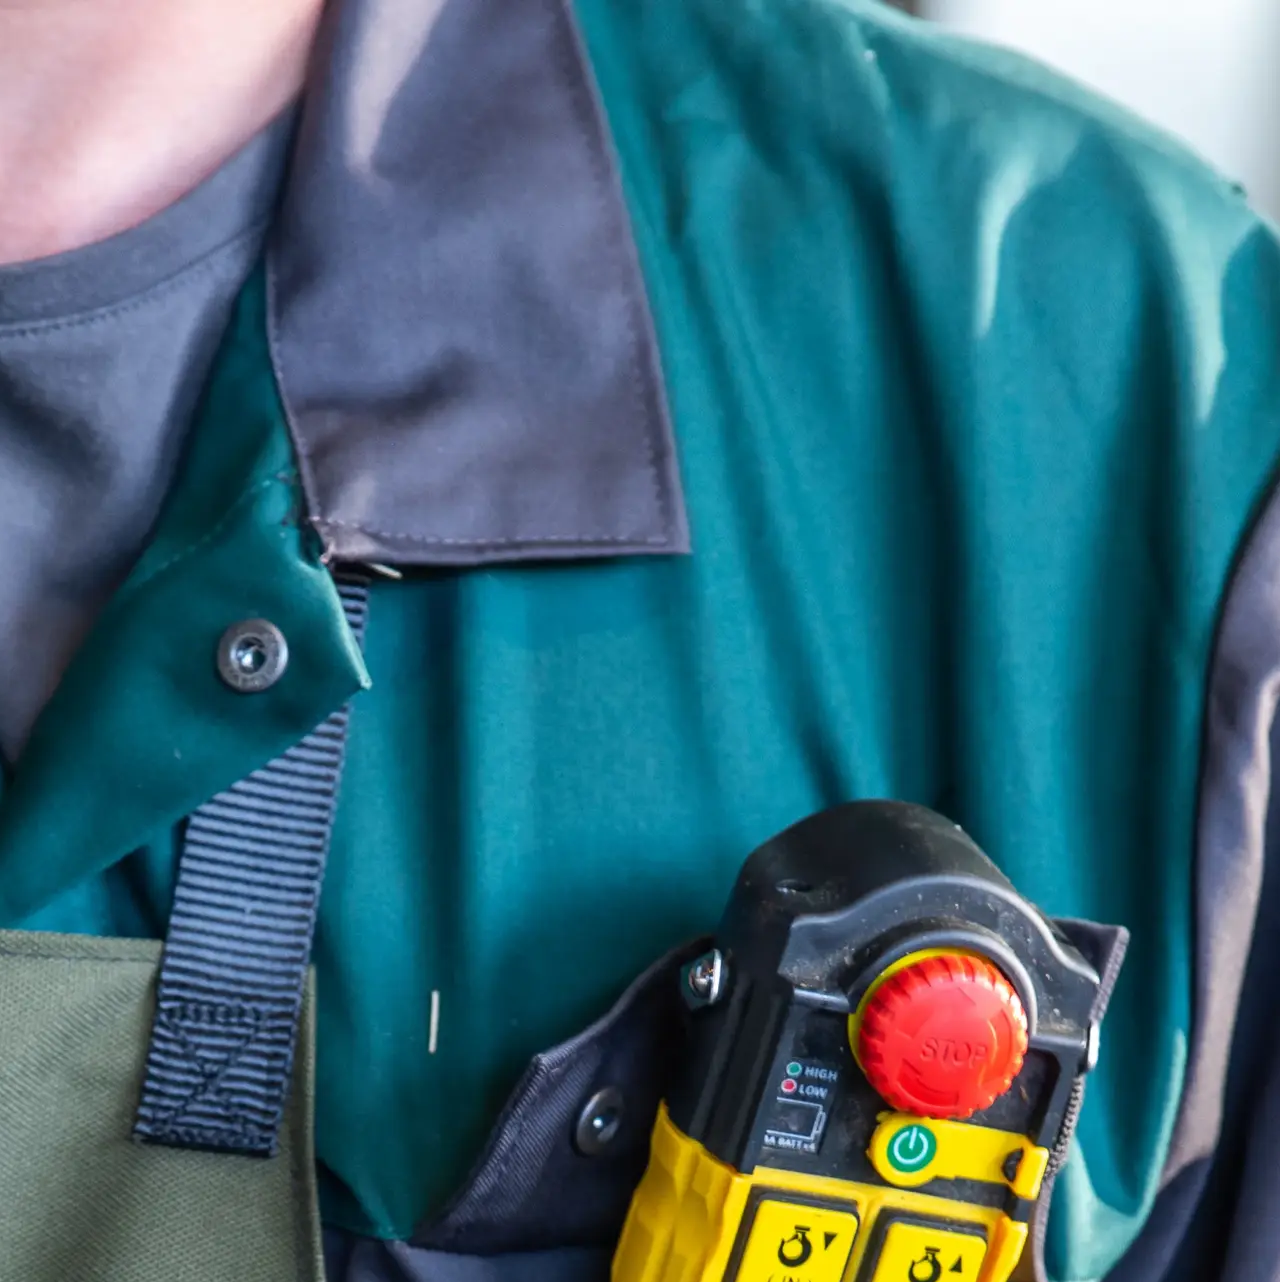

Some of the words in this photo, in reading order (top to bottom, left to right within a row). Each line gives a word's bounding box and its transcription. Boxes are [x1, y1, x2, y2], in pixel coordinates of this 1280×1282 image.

[921, 1037, 987, 1069] STOP
[804, 1066, 838, 1081] HIGH
[798, 1084, 828, 1098] LOW
